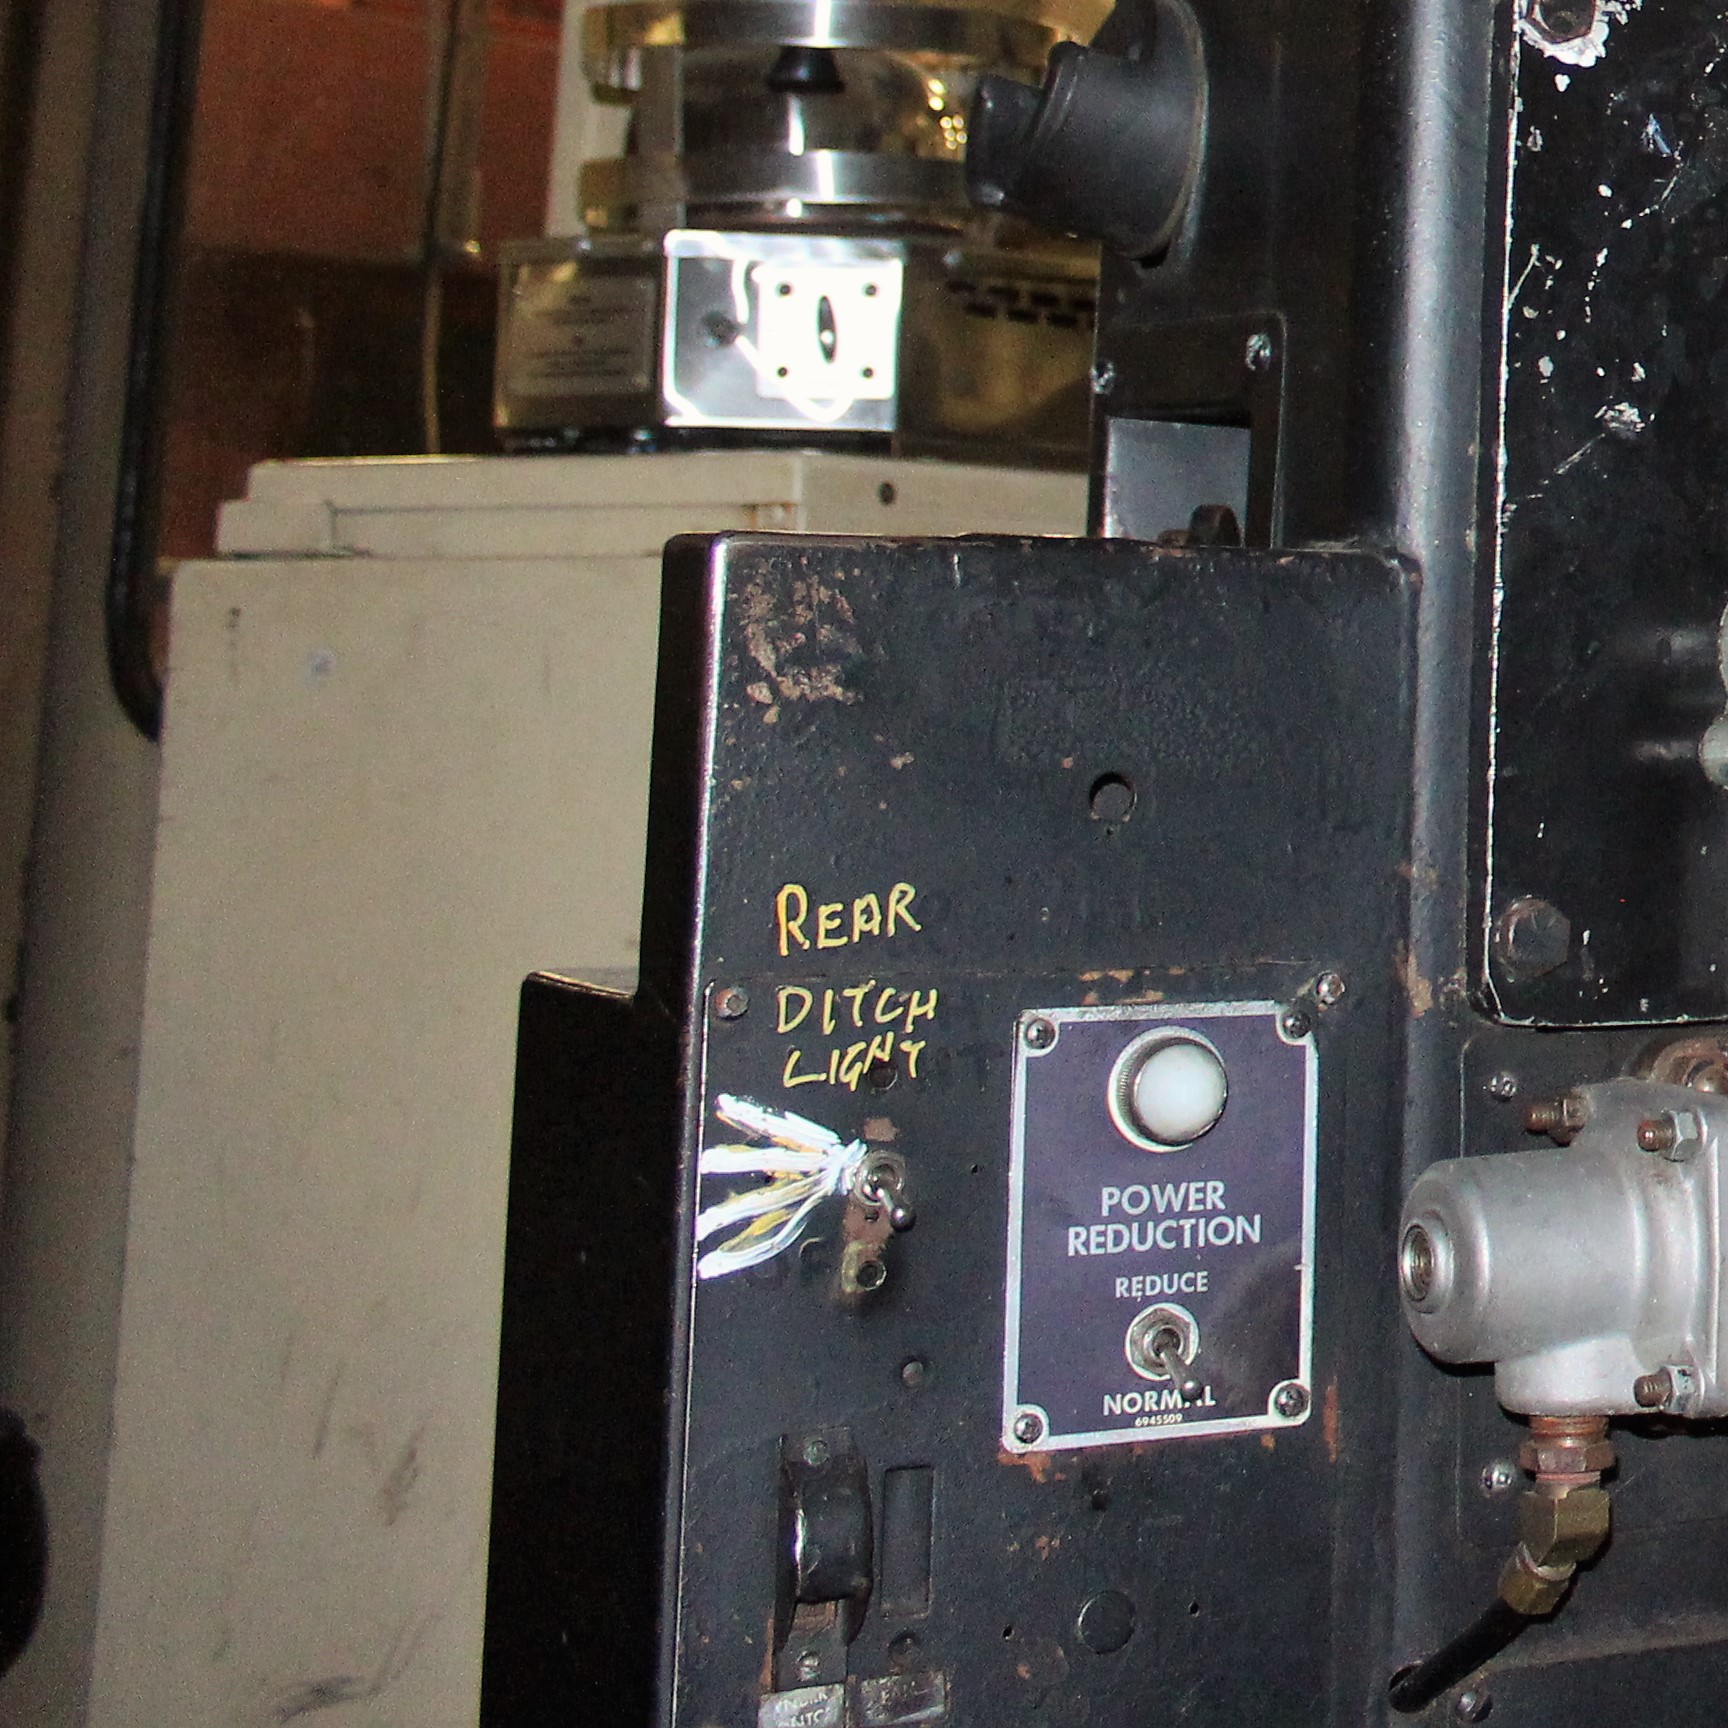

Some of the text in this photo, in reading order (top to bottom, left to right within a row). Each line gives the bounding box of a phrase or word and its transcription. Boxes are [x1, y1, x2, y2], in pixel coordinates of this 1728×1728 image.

[776, 883, 921, 957] REAR
[776, 985, 939, 1036] DITCH
[782, 1031, 925, 1091] LIGHT
[1101, 1180, 1226, 1216] POWER
[1067, 1213, 1262, 1257] REDUCTION
[1115, 1272, 1209, 1299] REDUCE
[1102, 1387, 1216, 1416] NORML
[1134, 1413, 1183, 1426] 6945509
